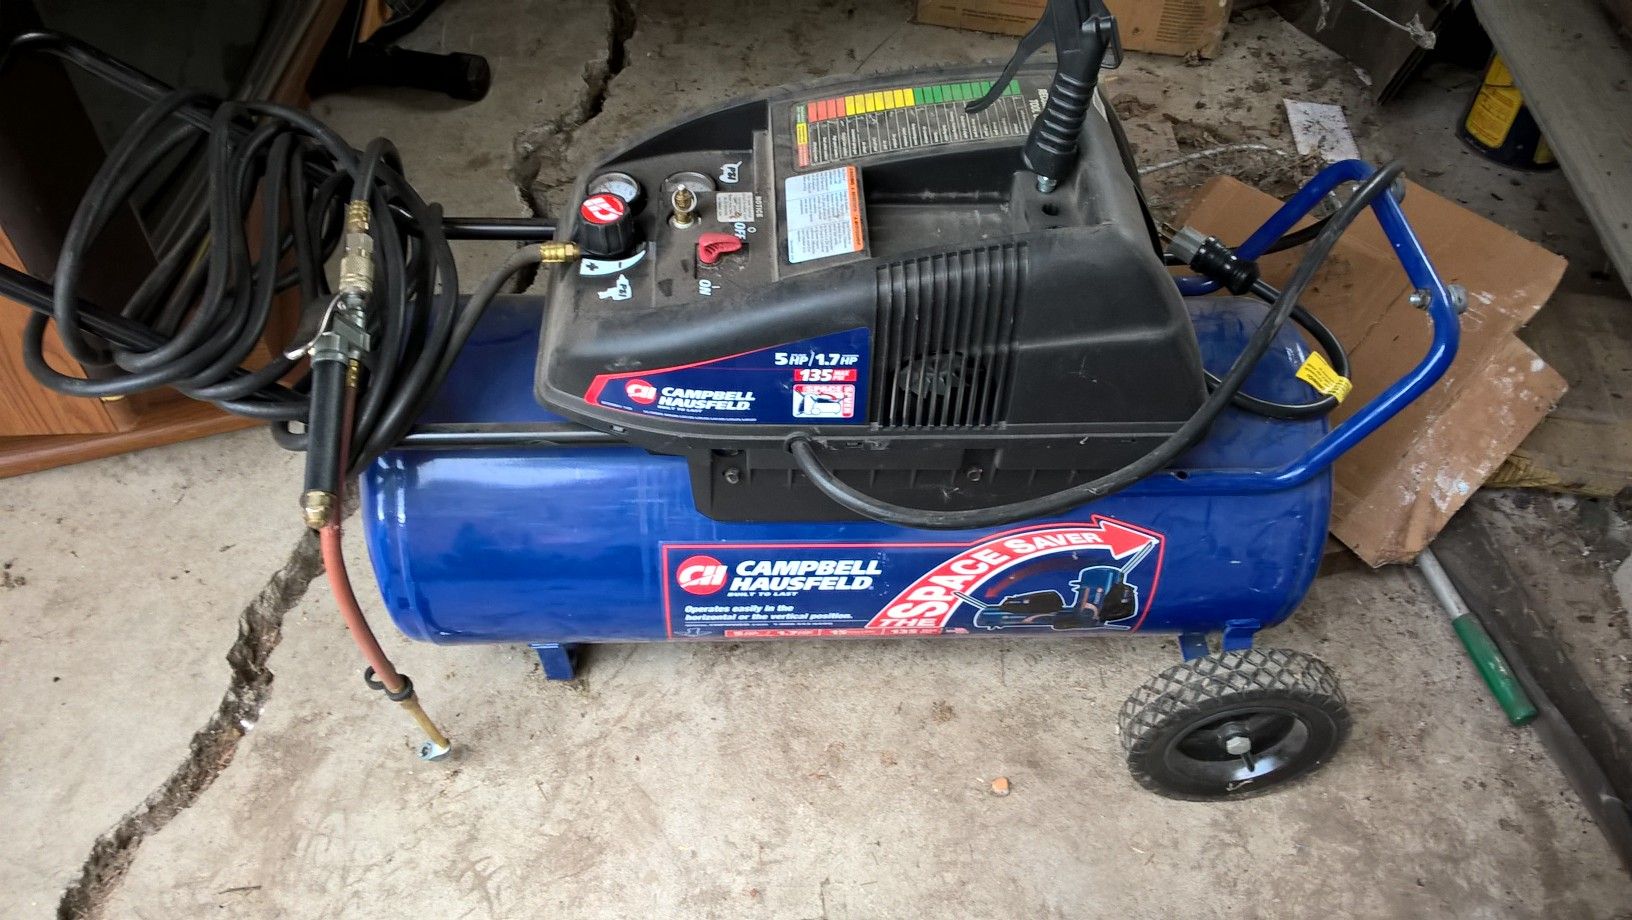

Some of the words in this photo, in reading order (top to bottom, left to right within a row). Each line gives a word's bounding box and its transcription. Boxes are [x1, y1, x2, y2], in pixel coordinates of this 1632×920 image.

[755, 195, 764, 218] NOTICE
[734, 222, 747, 240] OFF
[699, 279, 712, 296] ON
[799, 368, 833, 382] 135
[661, 386, 756, 401] CAMPBELL
[658, 396, 751, 411] HAUSFELD
[1003, 532, 1104, 555] SAVER
[735, 560, 882, 576] CAMPBELL
[729, 576, 873, 591] HAUSFELD
[886, 548, 1009, 620] SPACE
[684, 605, 731, 614] Operates
[732, 605, 763, 614] easily
[764, 604, 776, 612] in
[777, 604, 795, 612] the
[684, 613, 736, 621] horizontal
[770, 612, 808, 620] vertical
[809, 612, 853, 621] position.
[879, 618, 936, 627] THE
